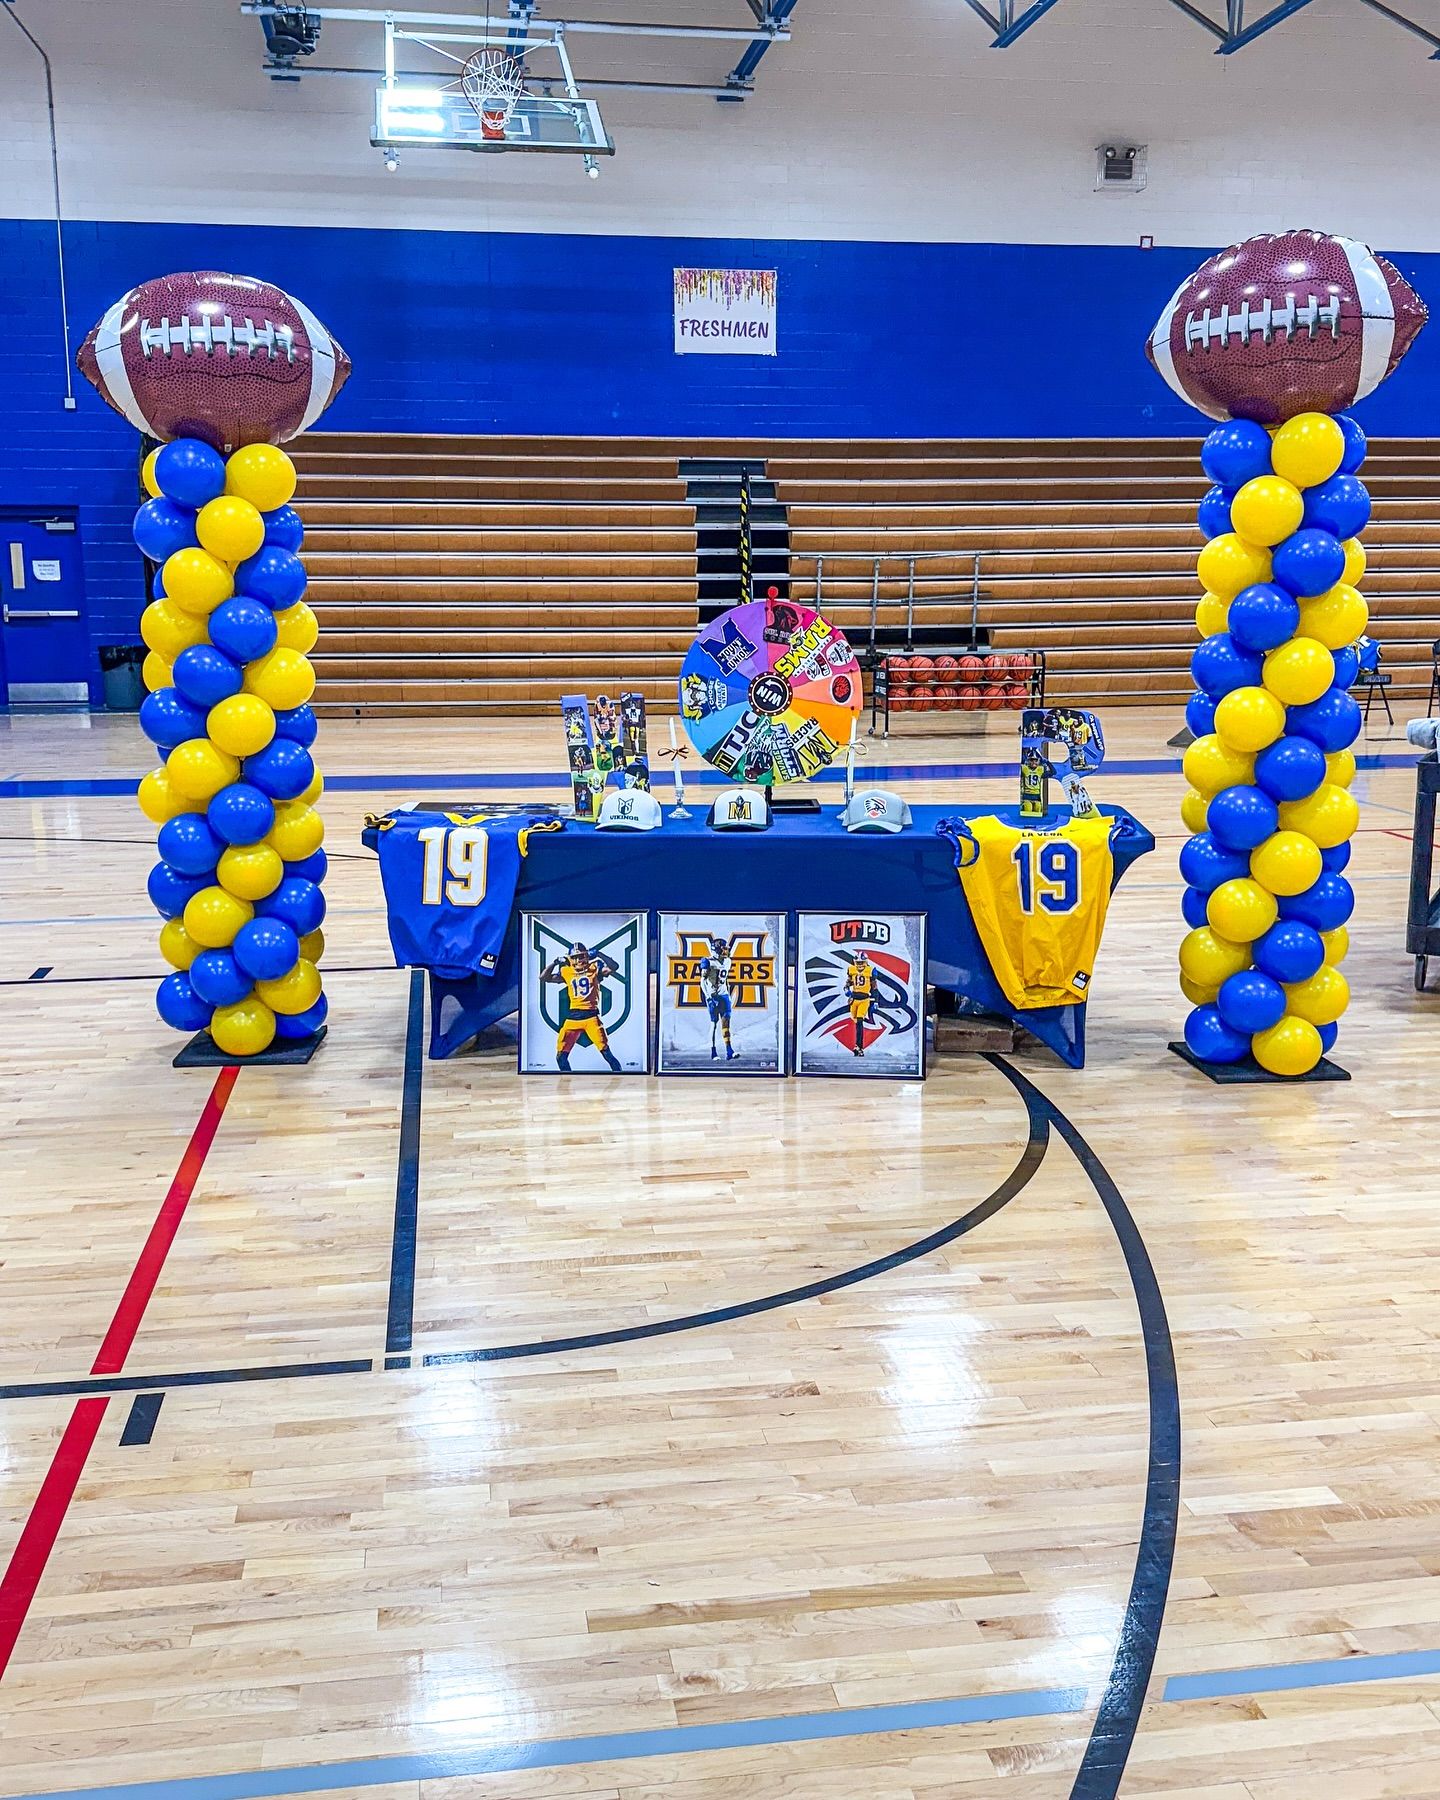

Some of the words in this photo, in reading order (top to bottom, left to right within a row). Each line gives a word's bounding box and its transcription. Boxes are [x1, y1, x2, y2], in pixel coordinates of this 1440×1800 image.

[679, 318, 769, 339] FRESHMEN
[718, 637, 742, 662] MOUNT
[728, 646, 751, 669] UNION
[773, 616, 833, 678] RAMS
[723, 710, 761, 752] TJC
[786, 716, 819, 749] RACERS
[772, 750, 791, 781] SAVAGE
[1028, 774, 1039, 786] 19
[610, 814, 639, 822] VIKINGS
[417, 827, 489, 907] 19
[1011, 839, 1082, 916] 19
[831, 920, 890, 942] UTPB
[486, 953, 494, 961] M
[673, 962, 770, 980] RAERS
[854, 975, 866, 986] 19
[1078, 972, 1087, 980] M
[571, 976, 590, 998] 19
